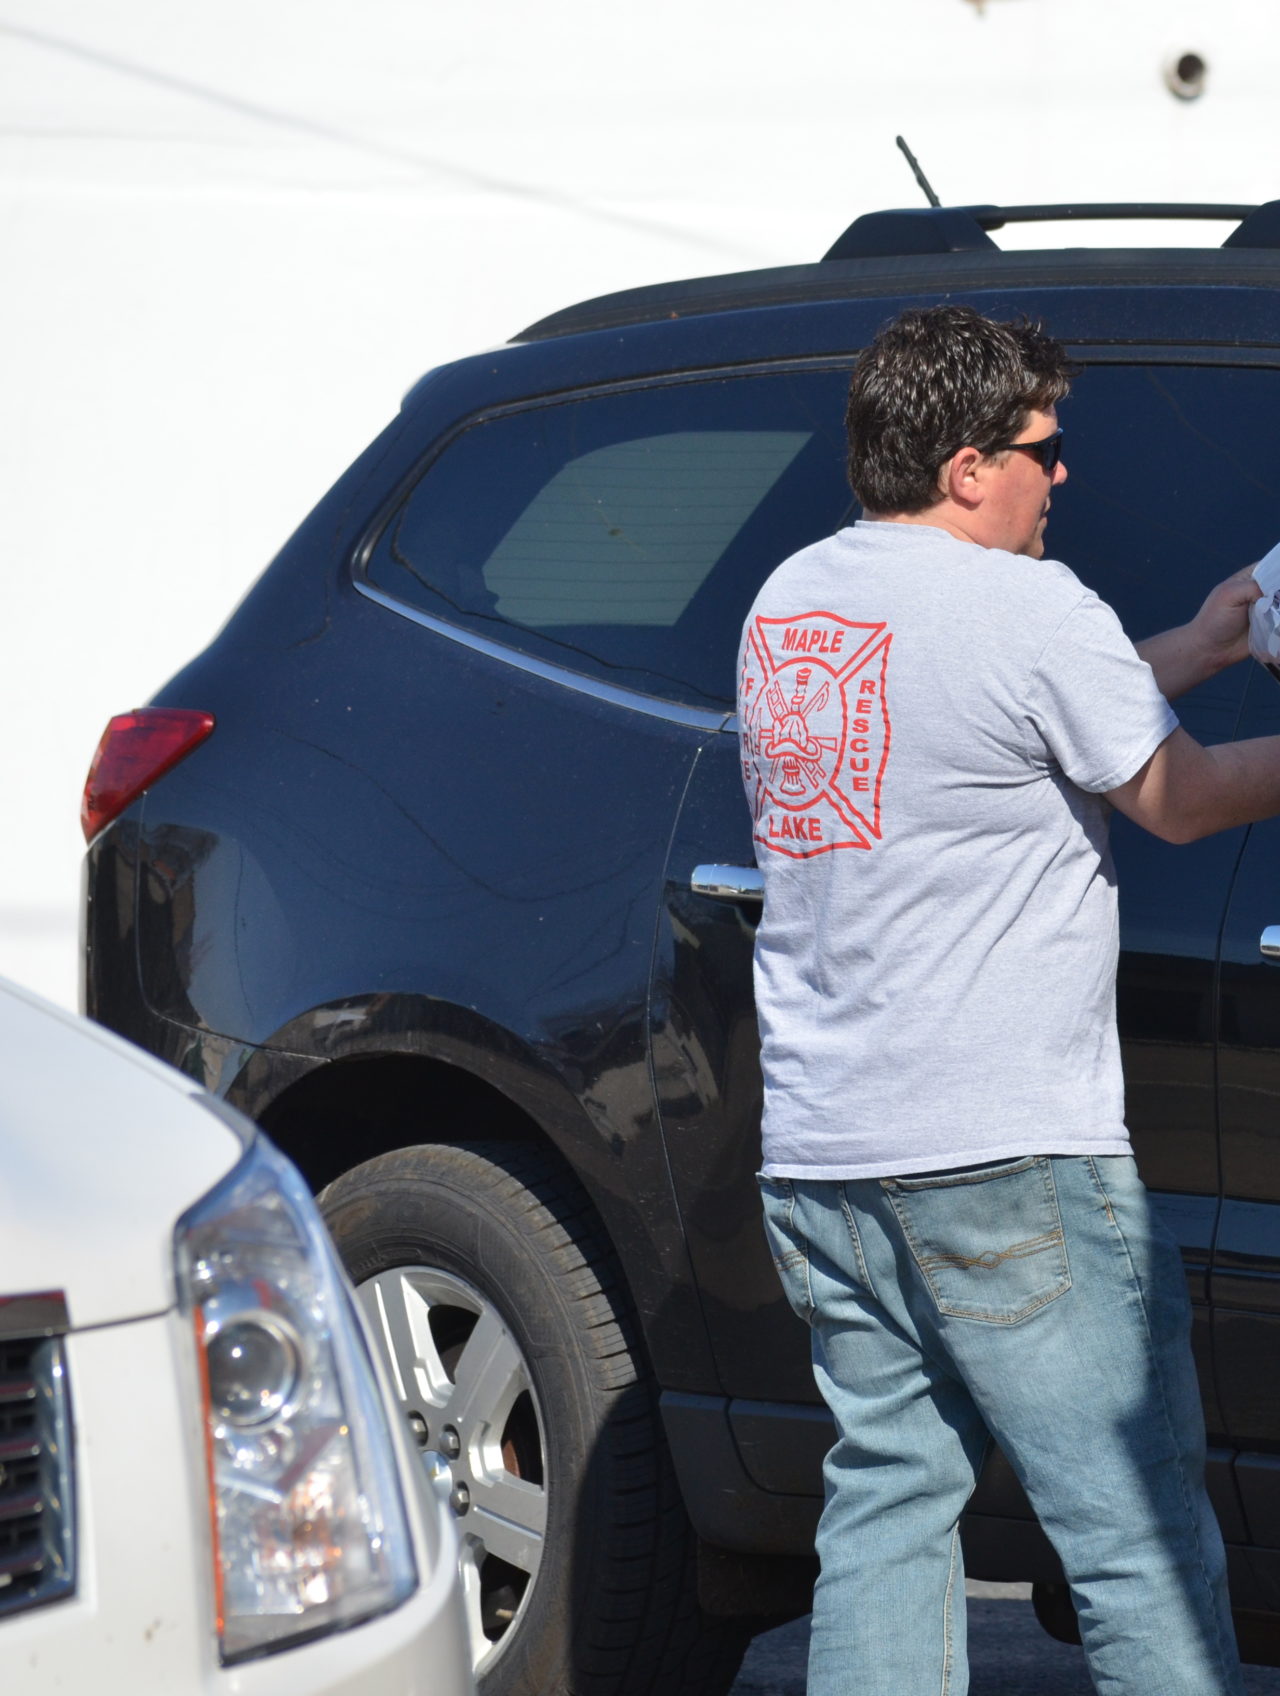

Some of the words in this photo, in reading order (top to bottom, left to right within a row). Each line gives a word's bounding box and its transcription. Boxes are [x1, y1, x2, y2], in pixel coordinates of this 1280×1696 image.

[781, 627, 845, 654] MAPLE
[741, 677, 755, 781] FIRE
[850, 679, 877, 792] RESCUE
[768, 815, 823, 841] LAKE
